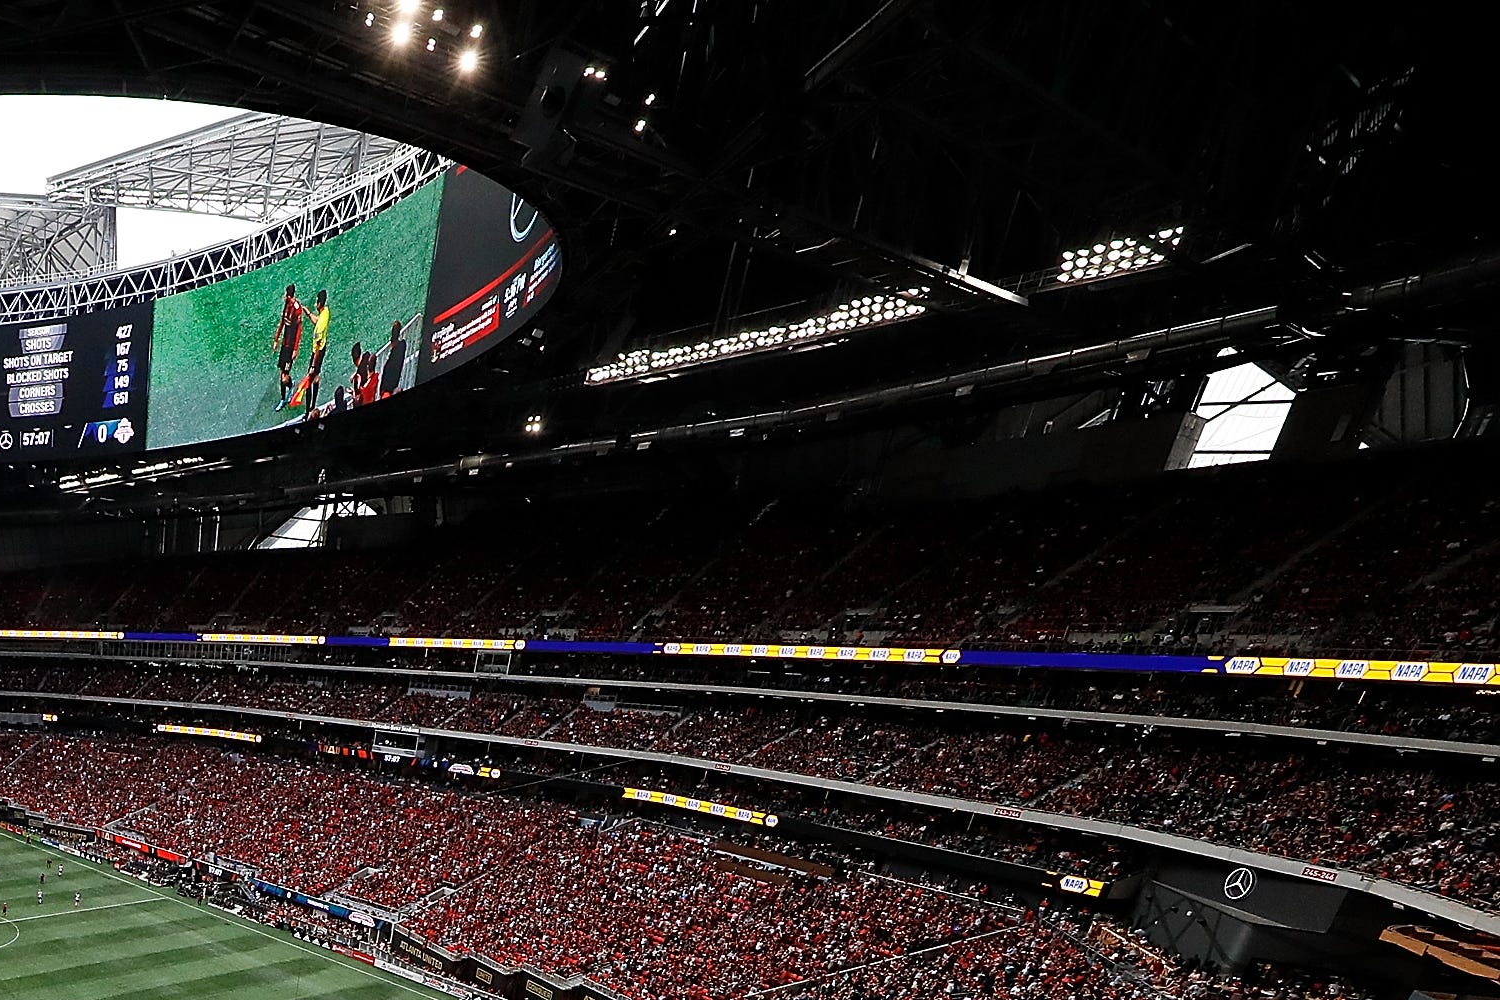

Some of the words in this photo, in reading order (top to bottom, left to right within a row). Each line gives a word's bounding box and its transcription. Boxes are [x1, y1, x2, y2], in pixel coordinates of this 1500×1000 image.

[116, 324, 132, 339] 427
[25, 338, 52, 350] SHOTS
[116, 341, 131, 356] 167
[3, 356, 30, 369] SHOTS
[30, 355, 43, 366] ON
[43, 350, 74, 365] TARGET
[117, 359, 129, 372] 75
[6, 371, 42, 385] BLOCKED
[42, 367, 70, 381] SHOTS
[114, 374, 130, 389] 149
[19, 386, 56, 398] CORNERS
[113, 391, 129, 405] 651
[19, 400, 56, 414] CROSSES
[22, 430, 50, 446] 57:07
[98, 427, 107, 443] 0
[1229, 660, 1255, 671] NAPA
[1287, 661, 1310, 672] NAPA
[1339, 662, 1364, 675] NAPA
[1395, 664, 1423, 677] NAPA
[1457, 666, 1490, 680] NAPA
[384, 754, 400, 763] 57:07
[208, 866, 222, 877] 57:07
[1303, 868, 1336, 881] 245-246
[1064, 877, 1087, 890] NAPA
[399, 940, 422, 960] ATLANTA
[422, 952, 443, 970] UNITED
[478, 968, 491, 983] UNITE
[528, 982, 552, 1000] CONQUER
